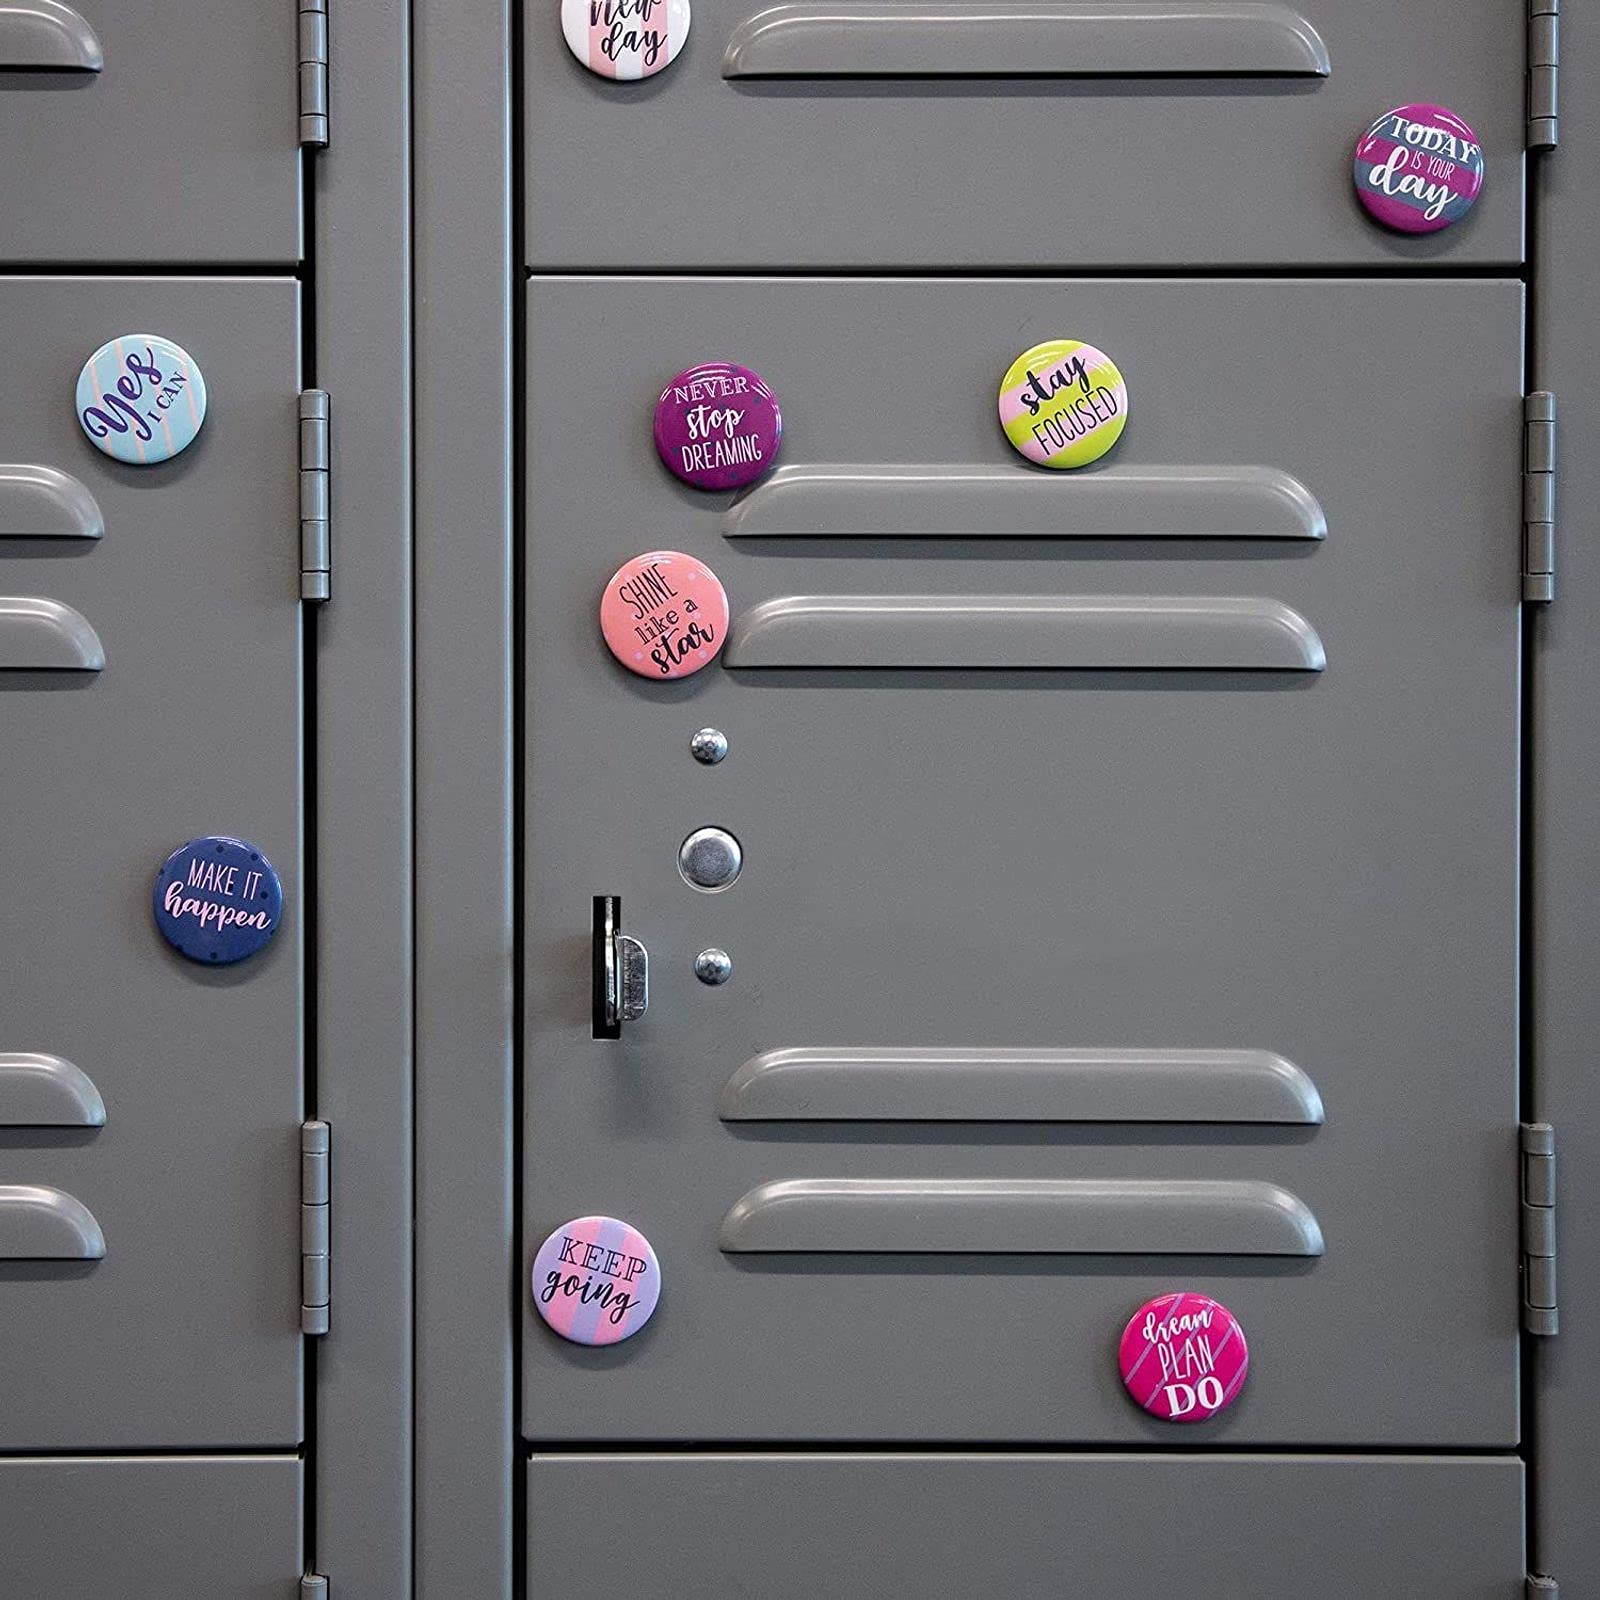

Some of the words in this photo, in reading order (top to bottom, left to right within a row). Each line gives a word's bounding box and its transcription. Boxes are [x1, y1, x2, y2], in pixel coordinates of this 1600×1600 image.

[601, 21, 668, 67] day
[1391, 115, 1480, 163] TODAY
[1369, 146, 1458, 220] day
[1411, 151, 1424, 170] IS
[1427, 156, 1455, 181] YOUR
[147, 410, 162, 423] I
[156, 371, 187, 410] CAN
[673, 376, 750, 404] NEVER
[1020, 356, 1085, 416] stay
[687, 404, 745, 440] stop
[1032, 386, 1117, 455] FOCUSED
[682, 434, 762, 472] DREAMING
[619, 563, 678, 619] SHINE
[634, 610, 679, 645] like
[683, 599, 698, 613] a
[651, 622, 714, 674] star
[187, 858, 239, 896] MAKE
[243, 871, 262, 900] IT
[164, 881, 271, 932] happen
[558, 1236, 647, 1282] KEEP
[541, 1270, 640, 1324] going
[1142, 1310, 1214, 1344] dream
[1158, 1334, 1214, 1381] PLAN
[1163, 1376, 1224, 1417] DO
